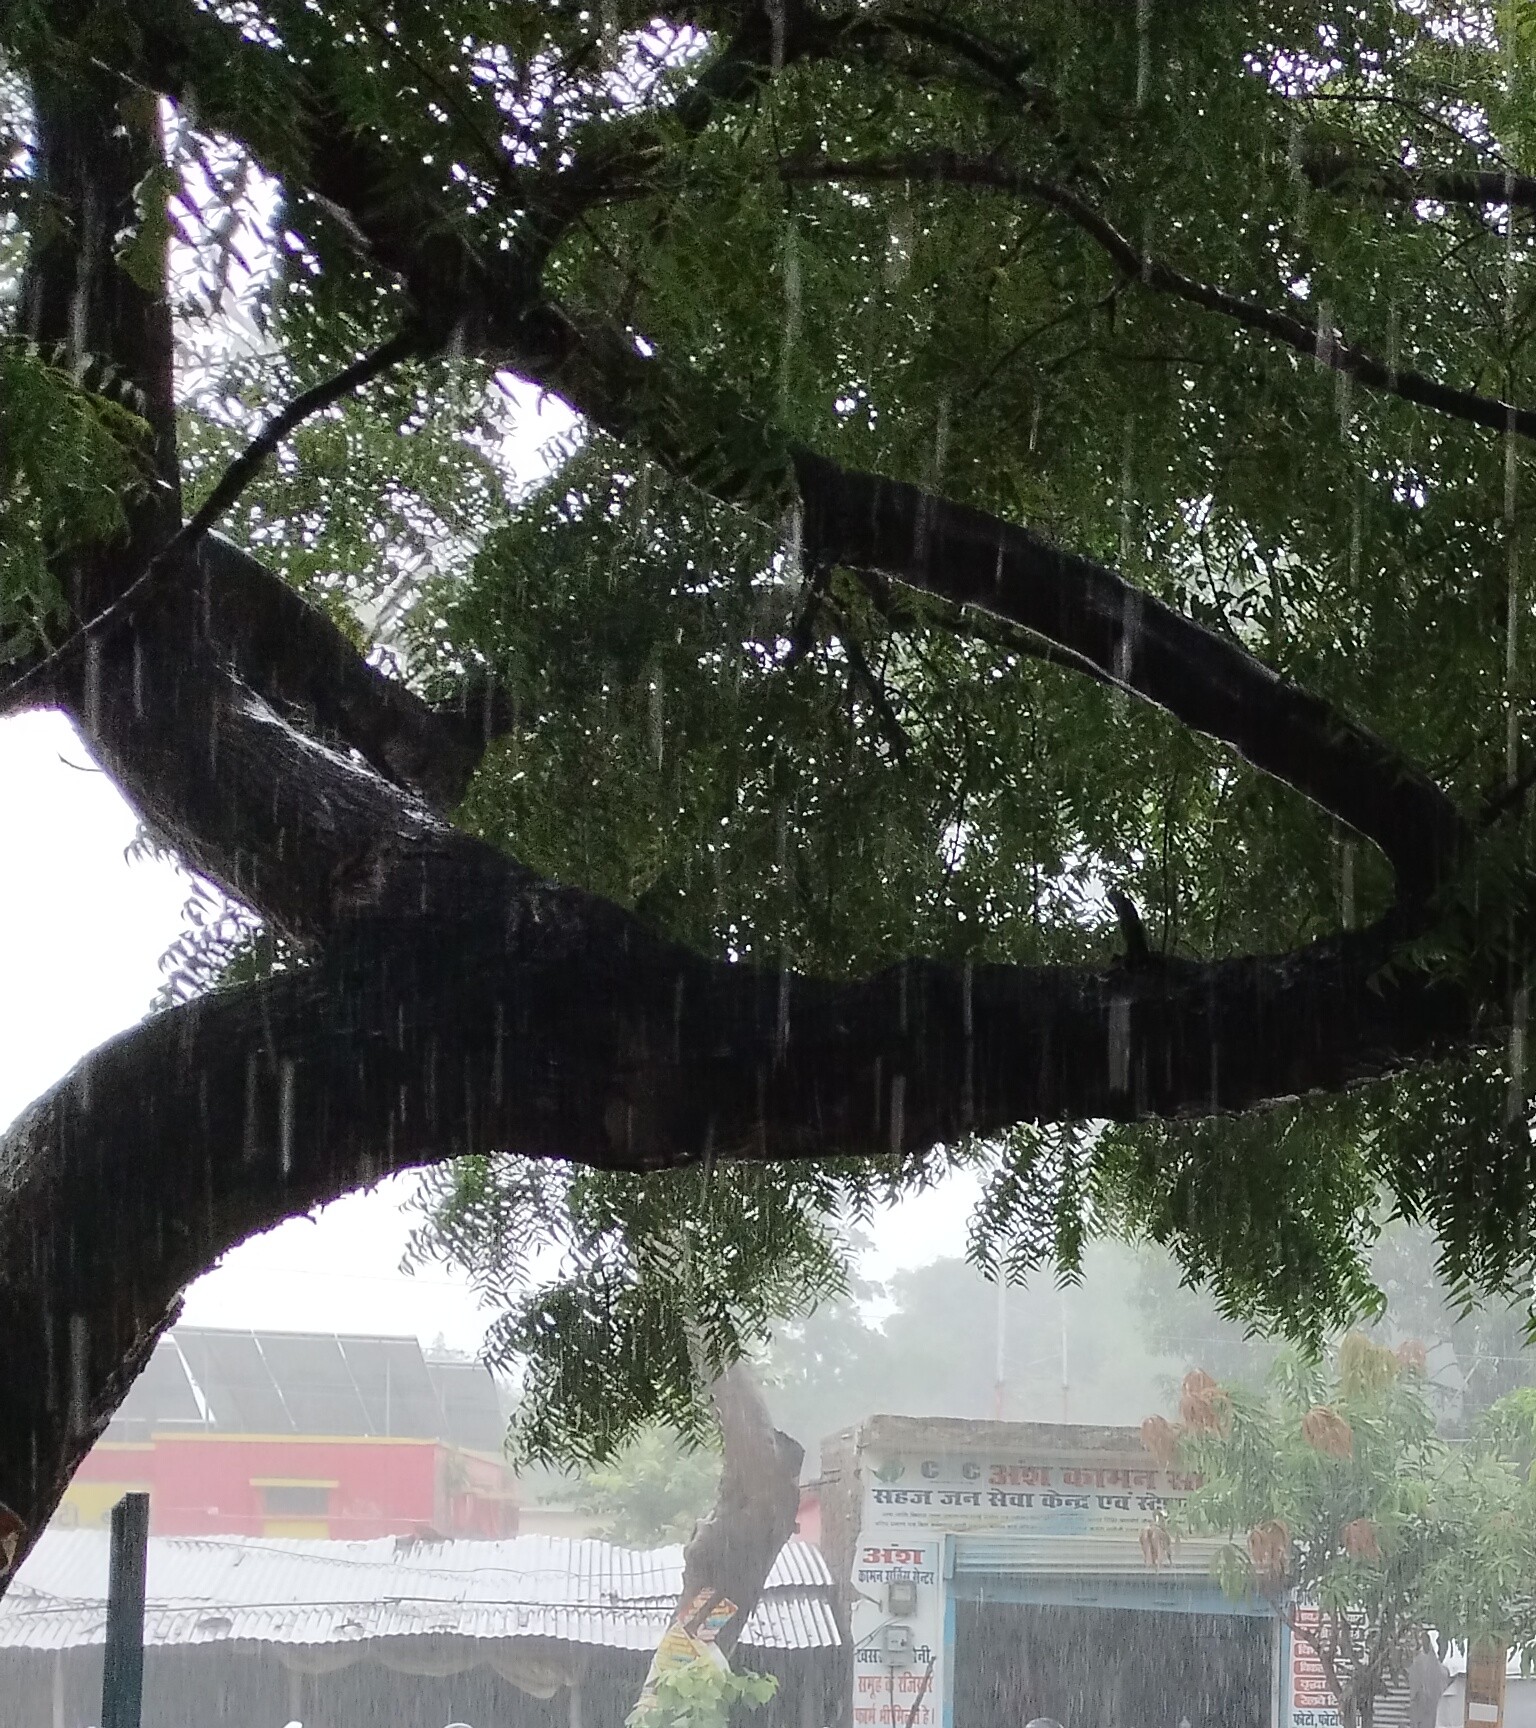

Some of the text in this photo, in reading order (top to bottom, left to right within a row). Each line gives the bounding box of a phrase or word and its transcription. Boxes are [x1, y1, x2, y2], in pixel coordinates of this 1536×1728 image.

[988, 1459, 1052, 1487] अंश
[1060, 1466, 1158, 1490] कामन
[872, 1488, 932, 1506] सहज
[937, 1489, 981, 1507] जन
[987, 1487, 1034, 1509] सेवा
[1040, 1489, 1091, 1511] केन्द्र
[1096, 1491, 1135, 1511] एवं
[863, 1543, 926, 1564] अंश
[858, 1675, 882, 1699] समूह
